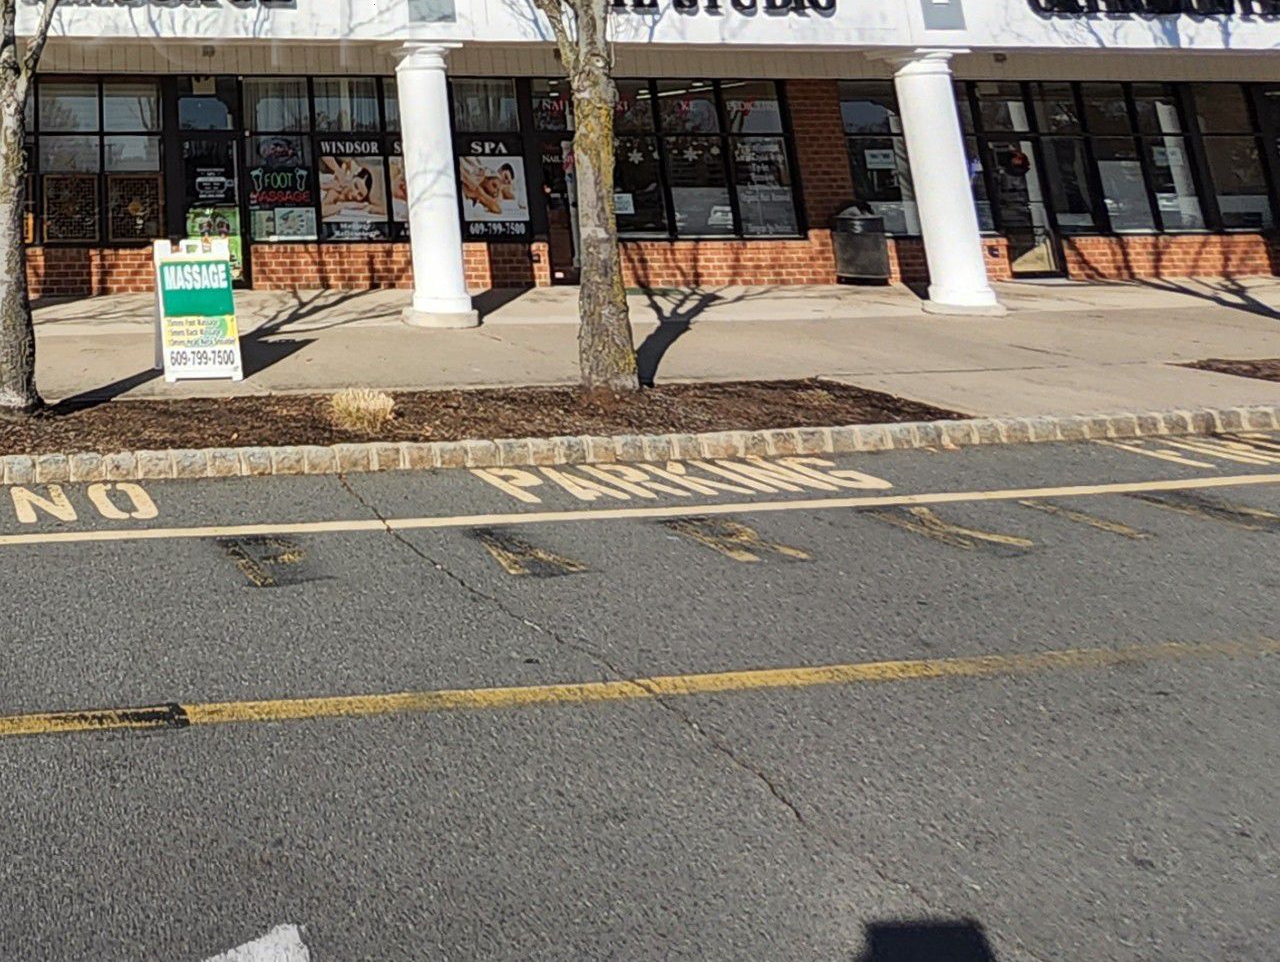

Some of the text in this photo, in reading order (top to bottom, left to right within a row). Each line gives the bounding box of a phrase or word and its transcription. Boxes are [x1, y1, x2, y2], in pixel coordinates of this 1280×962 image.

[320, 140, 379, 154] WINDSOR
[470, 140, 508, 154] SPA
[264, 171, 294, 189] FOOT
[162, 263, 228, 291] MASSAGE
[170, 349, 236, 367] 609-799-7500
[10, 481, 160, 524] NO
[468, 455, 893, 504] PARKING
